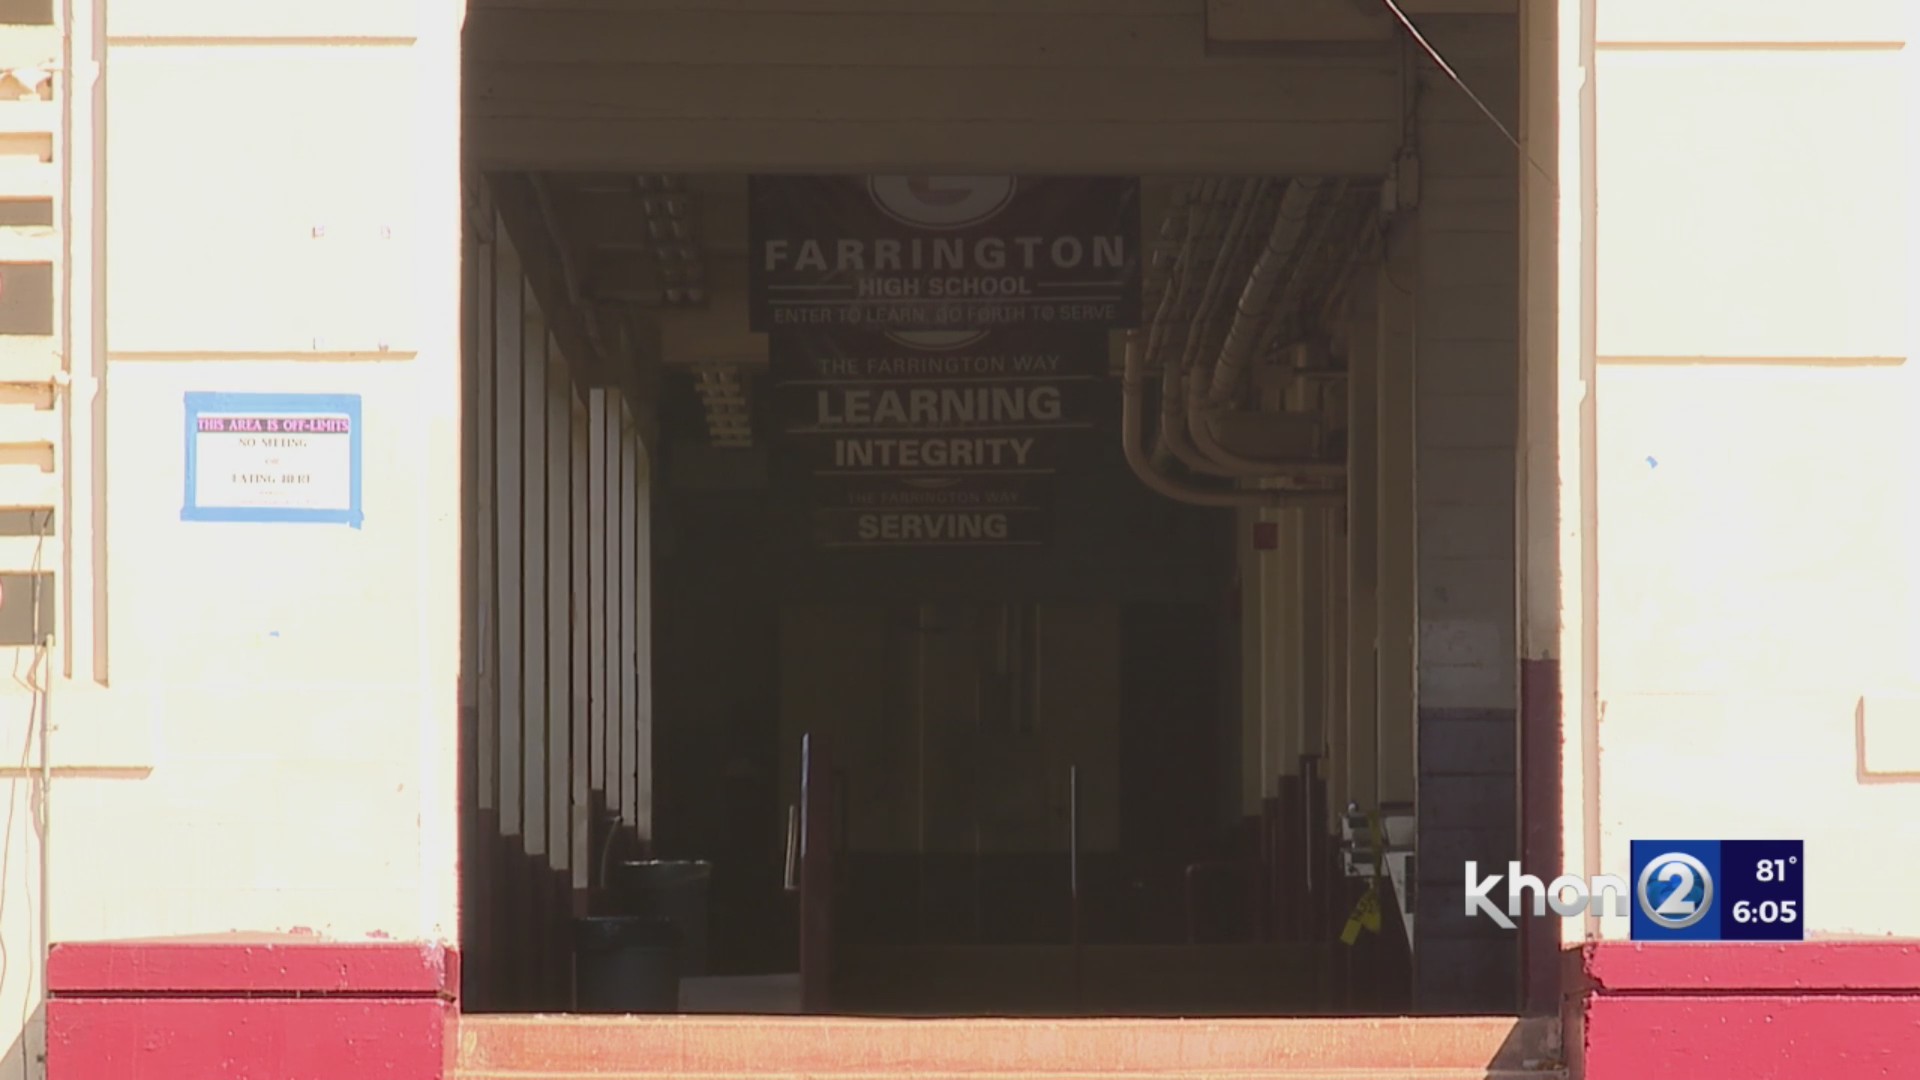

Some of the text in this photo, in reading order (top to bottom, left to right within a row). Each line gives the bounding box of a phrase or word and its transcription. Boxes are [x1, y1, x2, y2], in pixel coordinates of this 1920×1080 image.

[764, 235, 1124, 271] FARRINGTON
[858, 277, 1032, 297] HIGH SCHOOL
[774, 308, 832, 325] ENTER
[839, 307, 862, 324] TO
[1031, 304, 1055, 320] TO
[1059, 303, 1116, 320] SERVE
[818, 355, 1060, 375] THE FARRINGTON WAY
[817, 386, 1062, 424] LEARNING
[198, 418, 349, 431] THIS AREA IS OFF-LIMITS
[834, 438, 1034, 467] INTEGRITY
[858, 513, 1008, 539] SERVING
